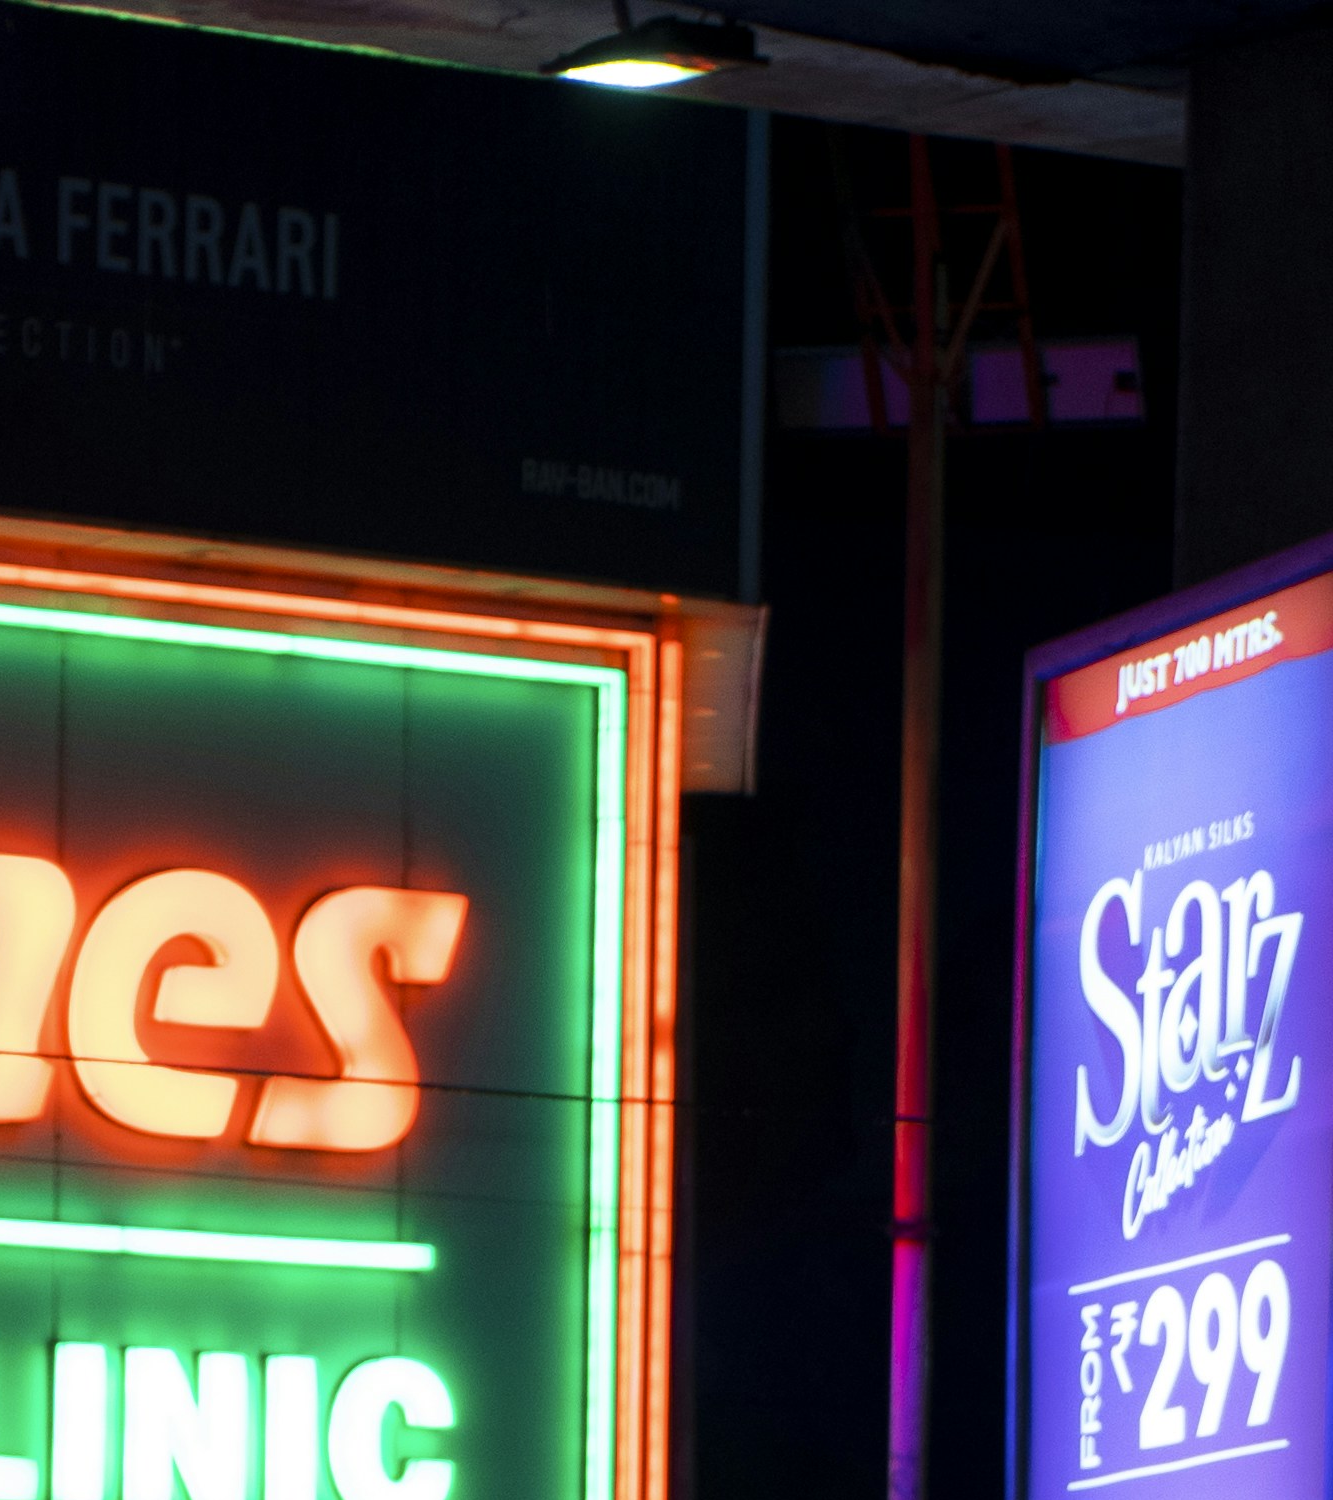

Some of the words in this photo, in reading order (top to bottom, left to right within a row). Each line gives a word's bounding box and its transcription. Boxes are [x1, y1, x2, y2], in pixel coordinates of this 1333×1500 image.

[56, 175, 339, 300] FERRARI
[1115, 653, 1172, 715] JUST
[1174, 635, 1211, 685] 700
[1212, 610, 1284, 672] MTRS.
[1143, 826, 1204, 871] KALYAN
[1207, 811, 1255, 851] SILKS
[1122, 1104, 1236, 1240] Collection
[1079, 1303, 1103, 1470] FROM
